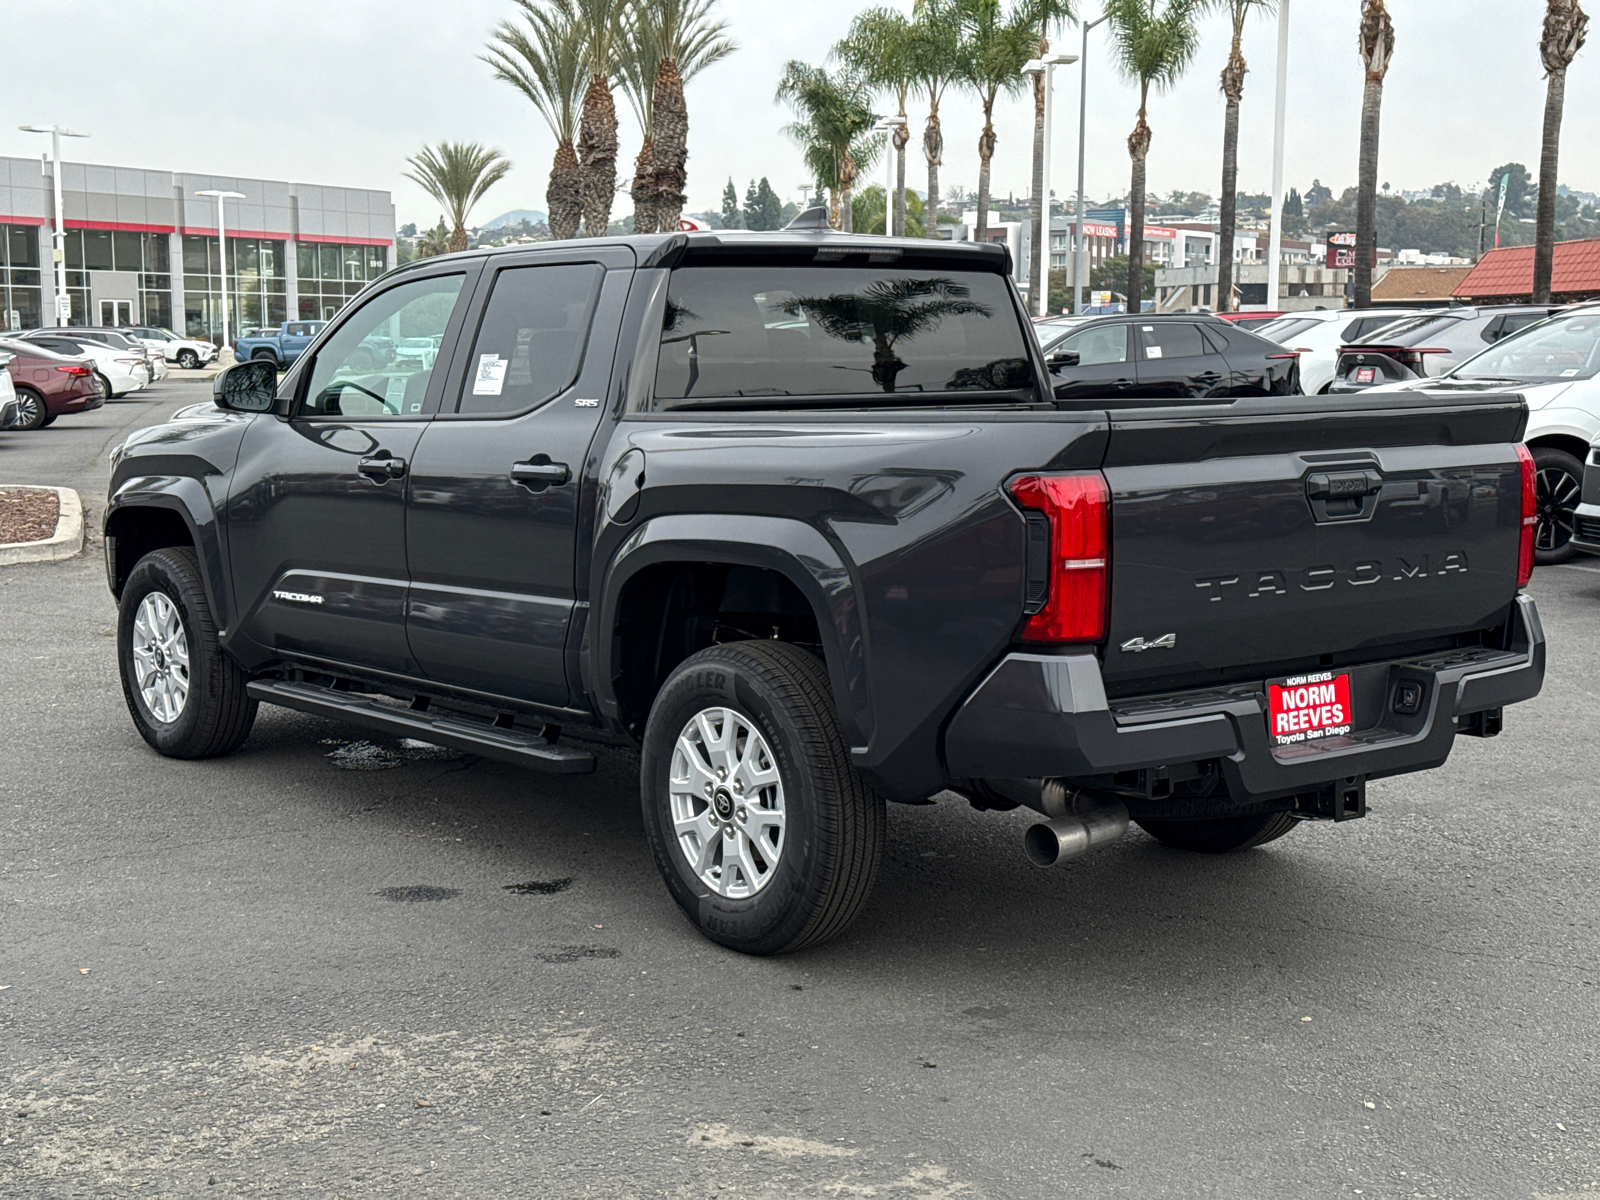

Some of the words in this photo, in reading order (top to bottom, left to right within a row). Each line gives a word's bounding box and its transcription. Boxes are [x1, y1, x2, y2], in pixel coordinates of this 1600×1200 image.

[1083, 224, 1095, 235] NOW
[1096, 225, 1117, 237] LEASING
[574, 398, 599, 408] SR5
[1331, 479, 1366, 492] TOYOTA
[1195, 551, 1468, 602] TACOMA
[273, 590, 326, 605] TACOMA
[1286, 675, 1307, 686] NORM
[1307, 672, 1332, 684] REEVES
[1281, 683, 1336, 710] NORM
[1276, 704, 1344, 733] REEVES
[1275, 732, 1305, 745] Toyota
[1306, 729, 1324, 740] San
[1325, 725, 1350, 736] Diego
